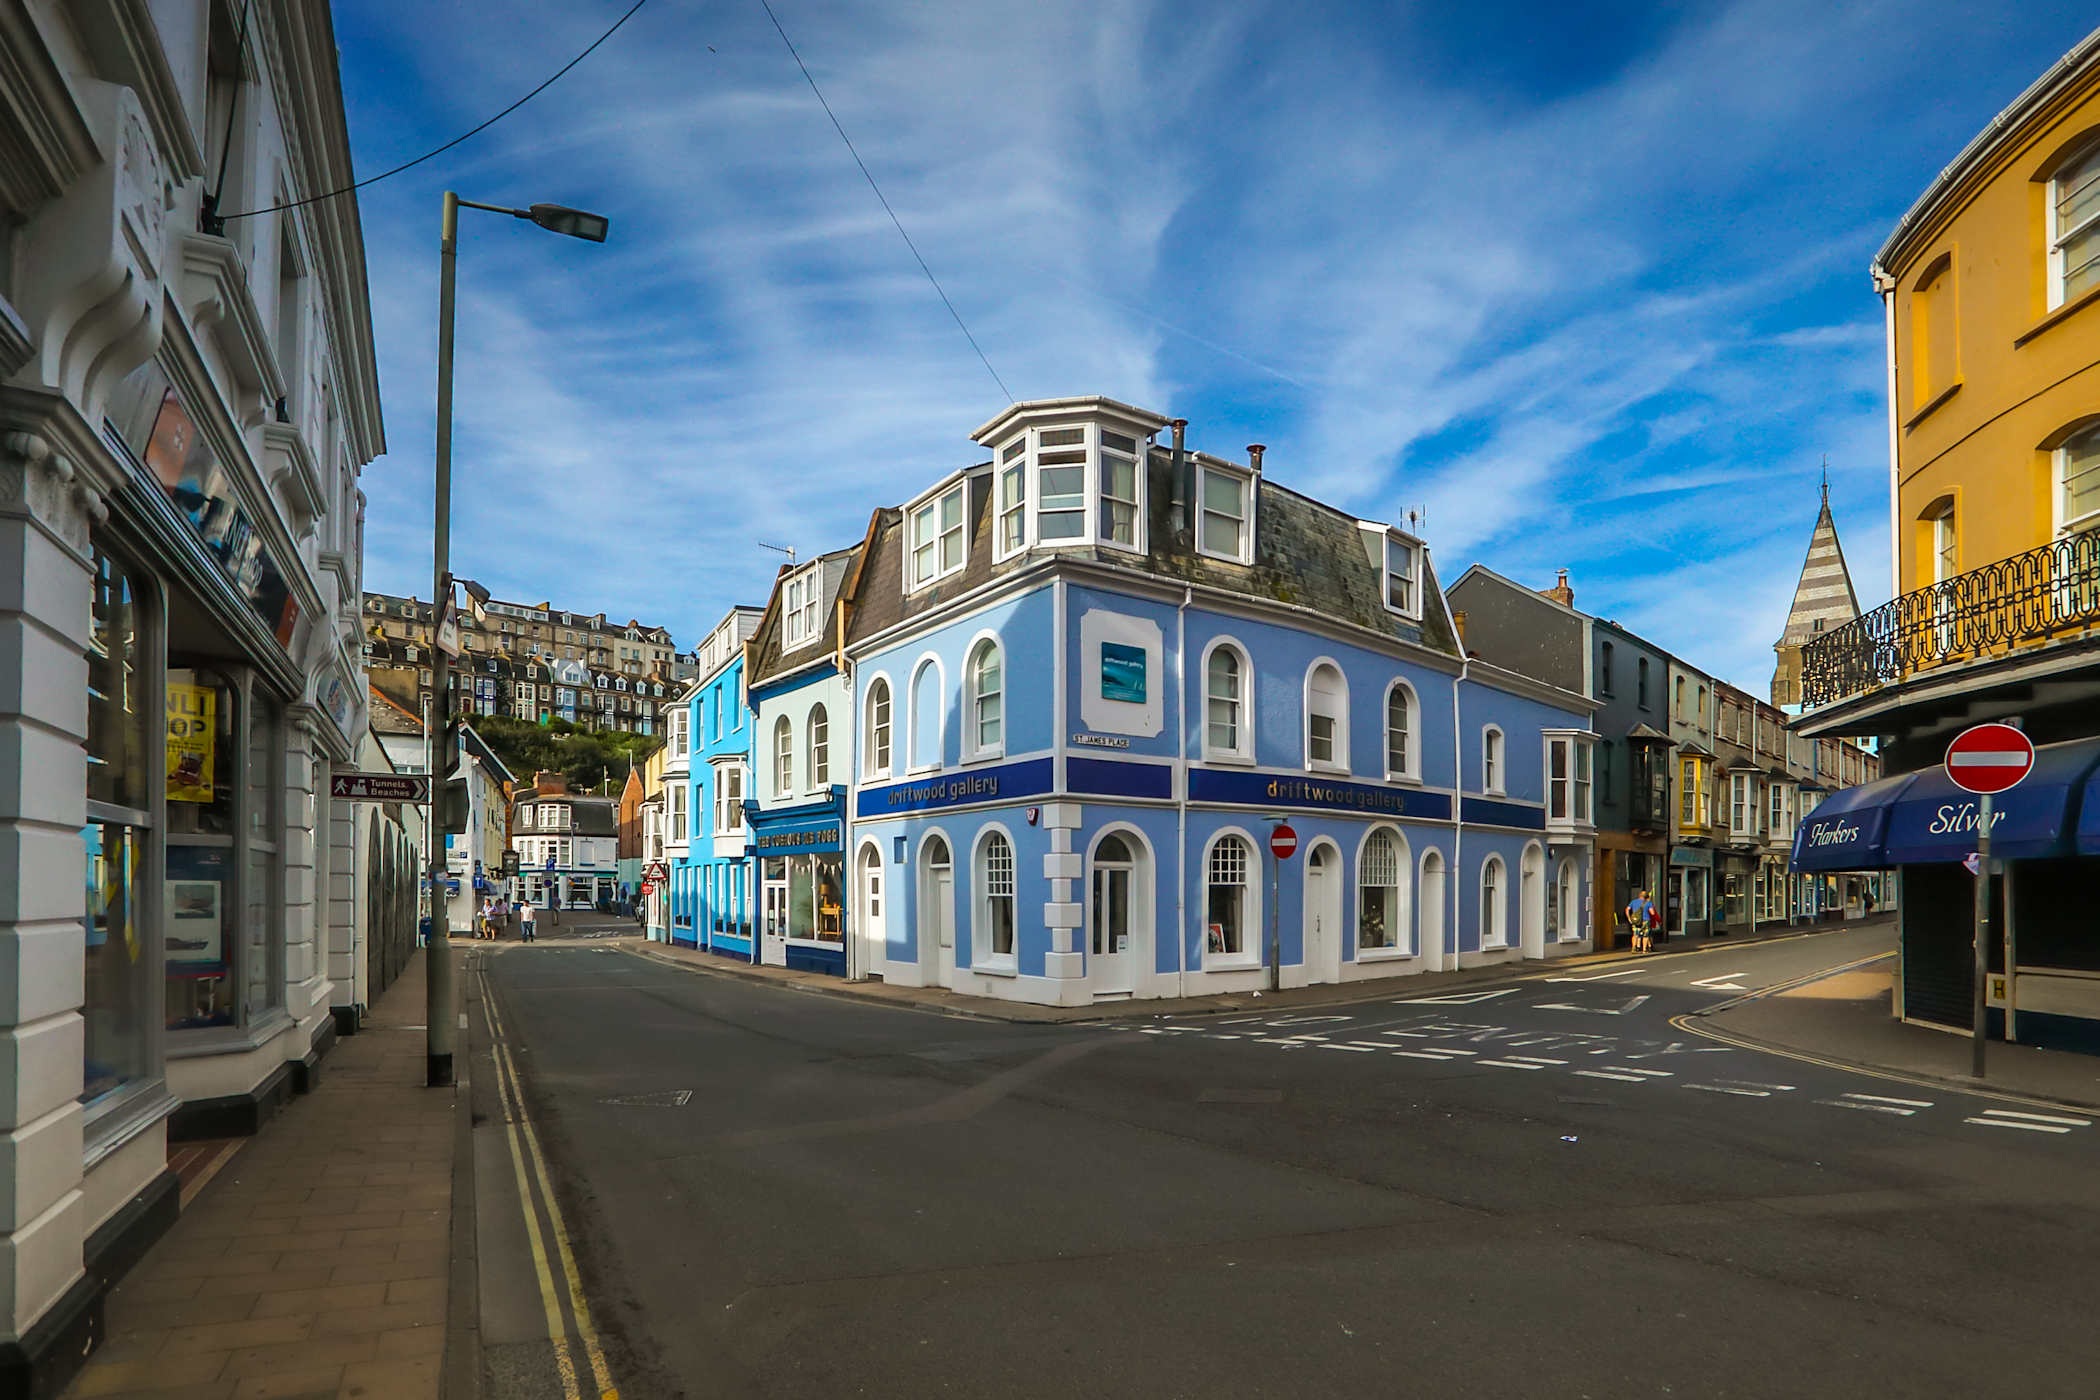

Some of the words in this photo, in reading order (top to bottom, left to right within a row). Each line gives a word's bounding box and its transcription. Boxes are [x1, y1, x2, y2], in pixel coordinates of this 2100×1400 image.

[370, 779, 406, 788] Tunnels
[370, 788, 410, 797] Beaches
[887, 781, 946, 805] driftwood
[950, 776, 998, 801] gallery
[1267, 779, 1353, 804] driftwood
[1358, 790, 1405, 811] gallery
[1809, 819, 1860, 847] Harkers
